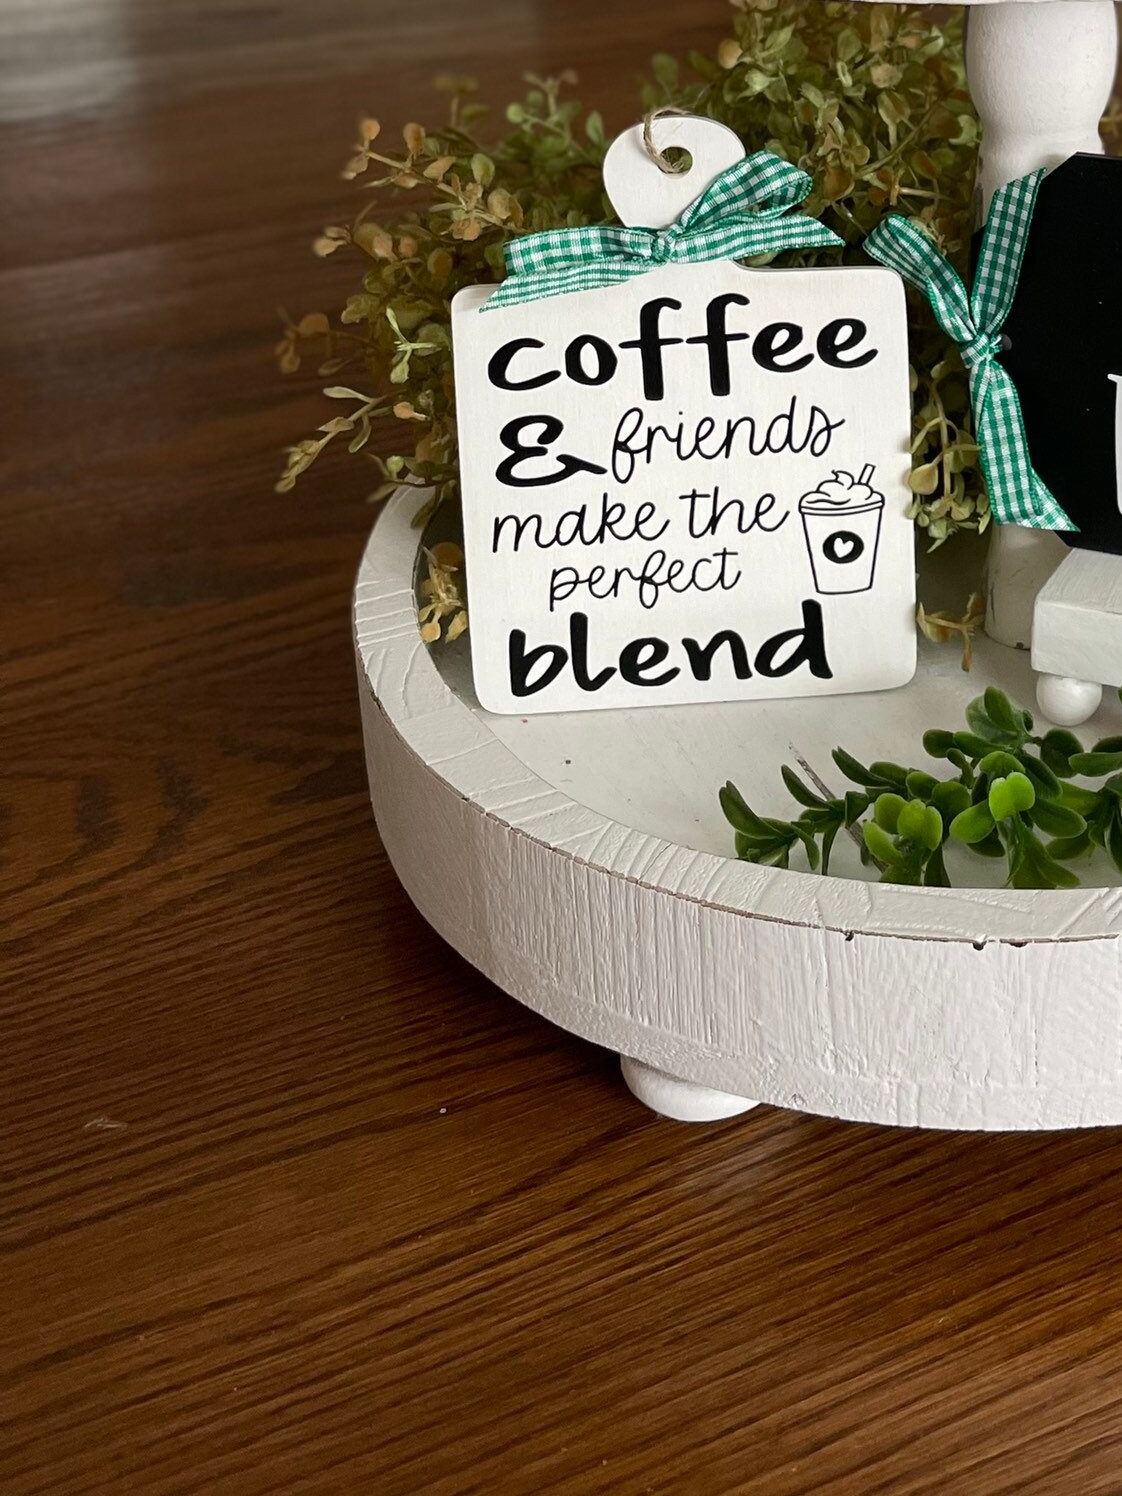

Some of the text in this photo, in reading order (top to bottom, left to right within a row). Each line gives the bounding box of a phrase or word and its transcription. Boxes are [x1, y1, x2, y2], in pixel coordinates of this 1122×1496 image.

[487, 293, 878, 401] coffee
[495, 395, 846, 488] & friends
[492, 486, 791, 553] make the
[550, 547, 741, 612] perfect
[508, 598, 833, 698] blend
